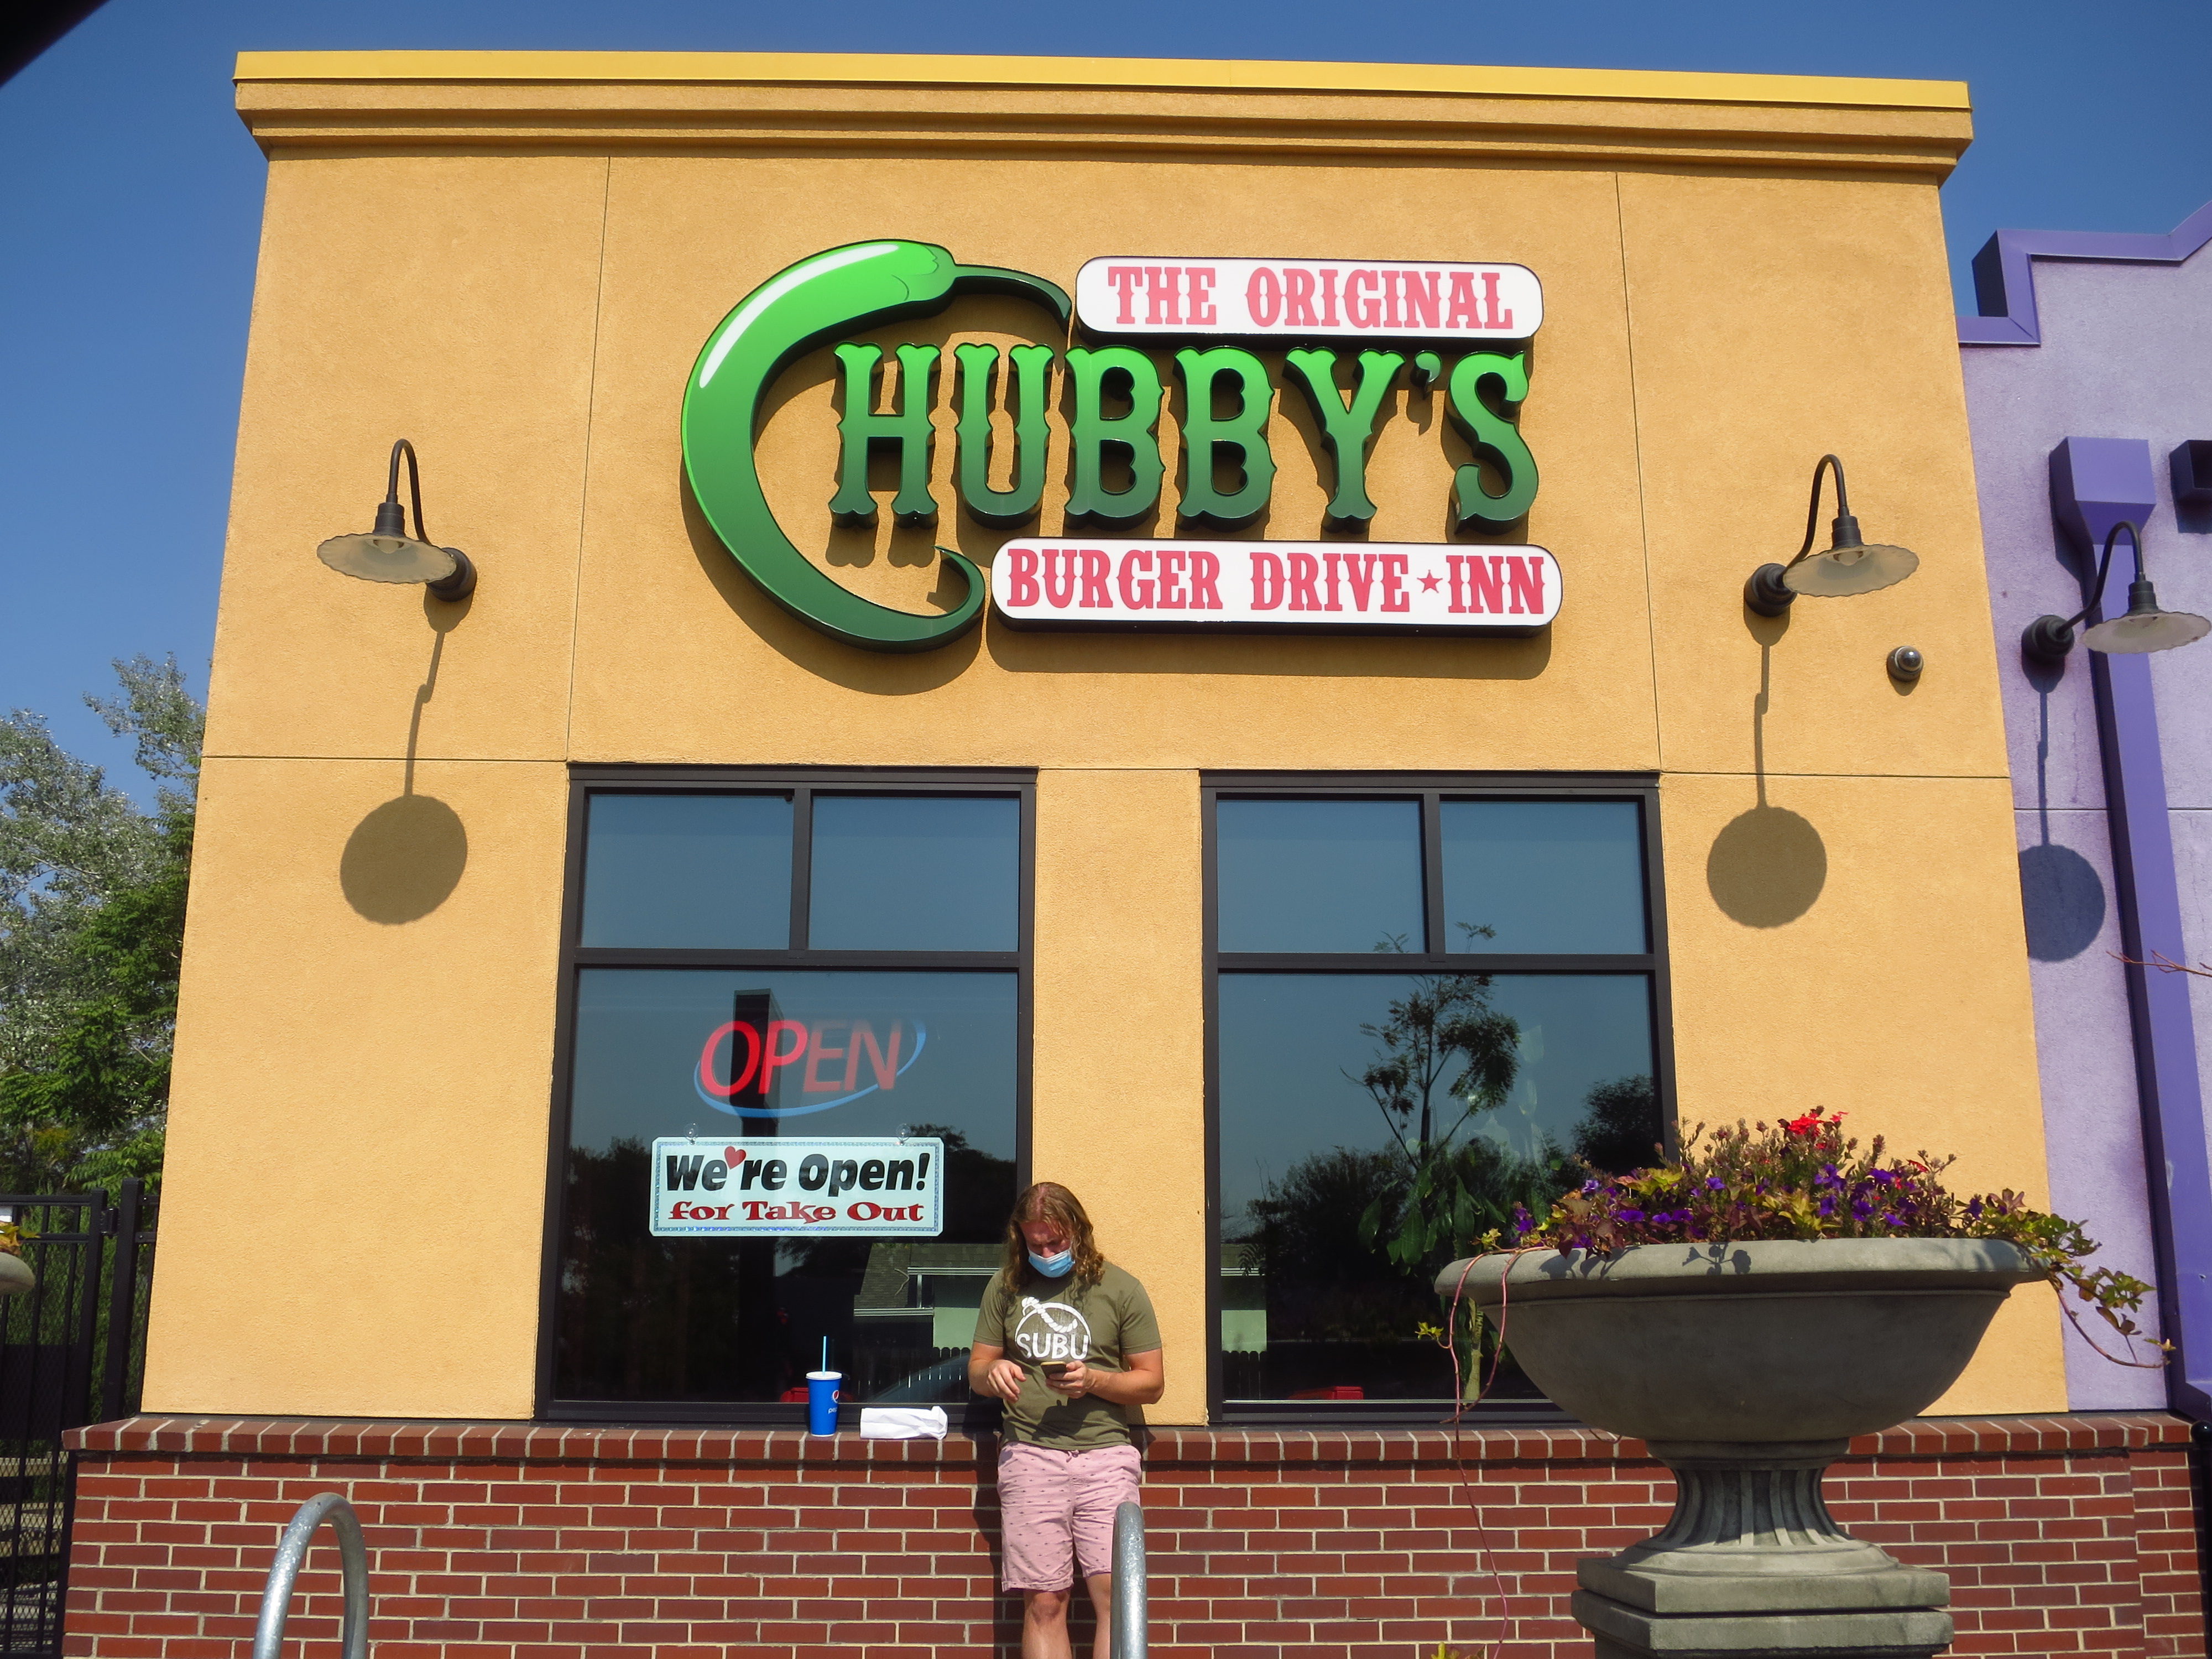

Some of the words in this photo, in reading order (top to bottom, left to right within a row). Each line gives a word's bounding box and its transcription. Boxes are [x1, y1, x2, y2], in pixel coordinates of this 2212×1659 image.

[1108, 266, 1217, 325] THE
[1244, 267, 1514, 330] ORIGINAL
[1006, 549, 1223, 611] BURGER
[1250, 552, 1411, 612] DRIVE
[1446, 555, 1545, 614] INN
[700, 1019, 902, 1096] OPEN
[799, 1152, 930, 1197] Open!
[668, 1201, 735, 1220] for
[742, 1201, 836, 1224] Take
[847, 1202, 924, 1222] Out
[1016, 1332, 1089, 1360] SUBU
